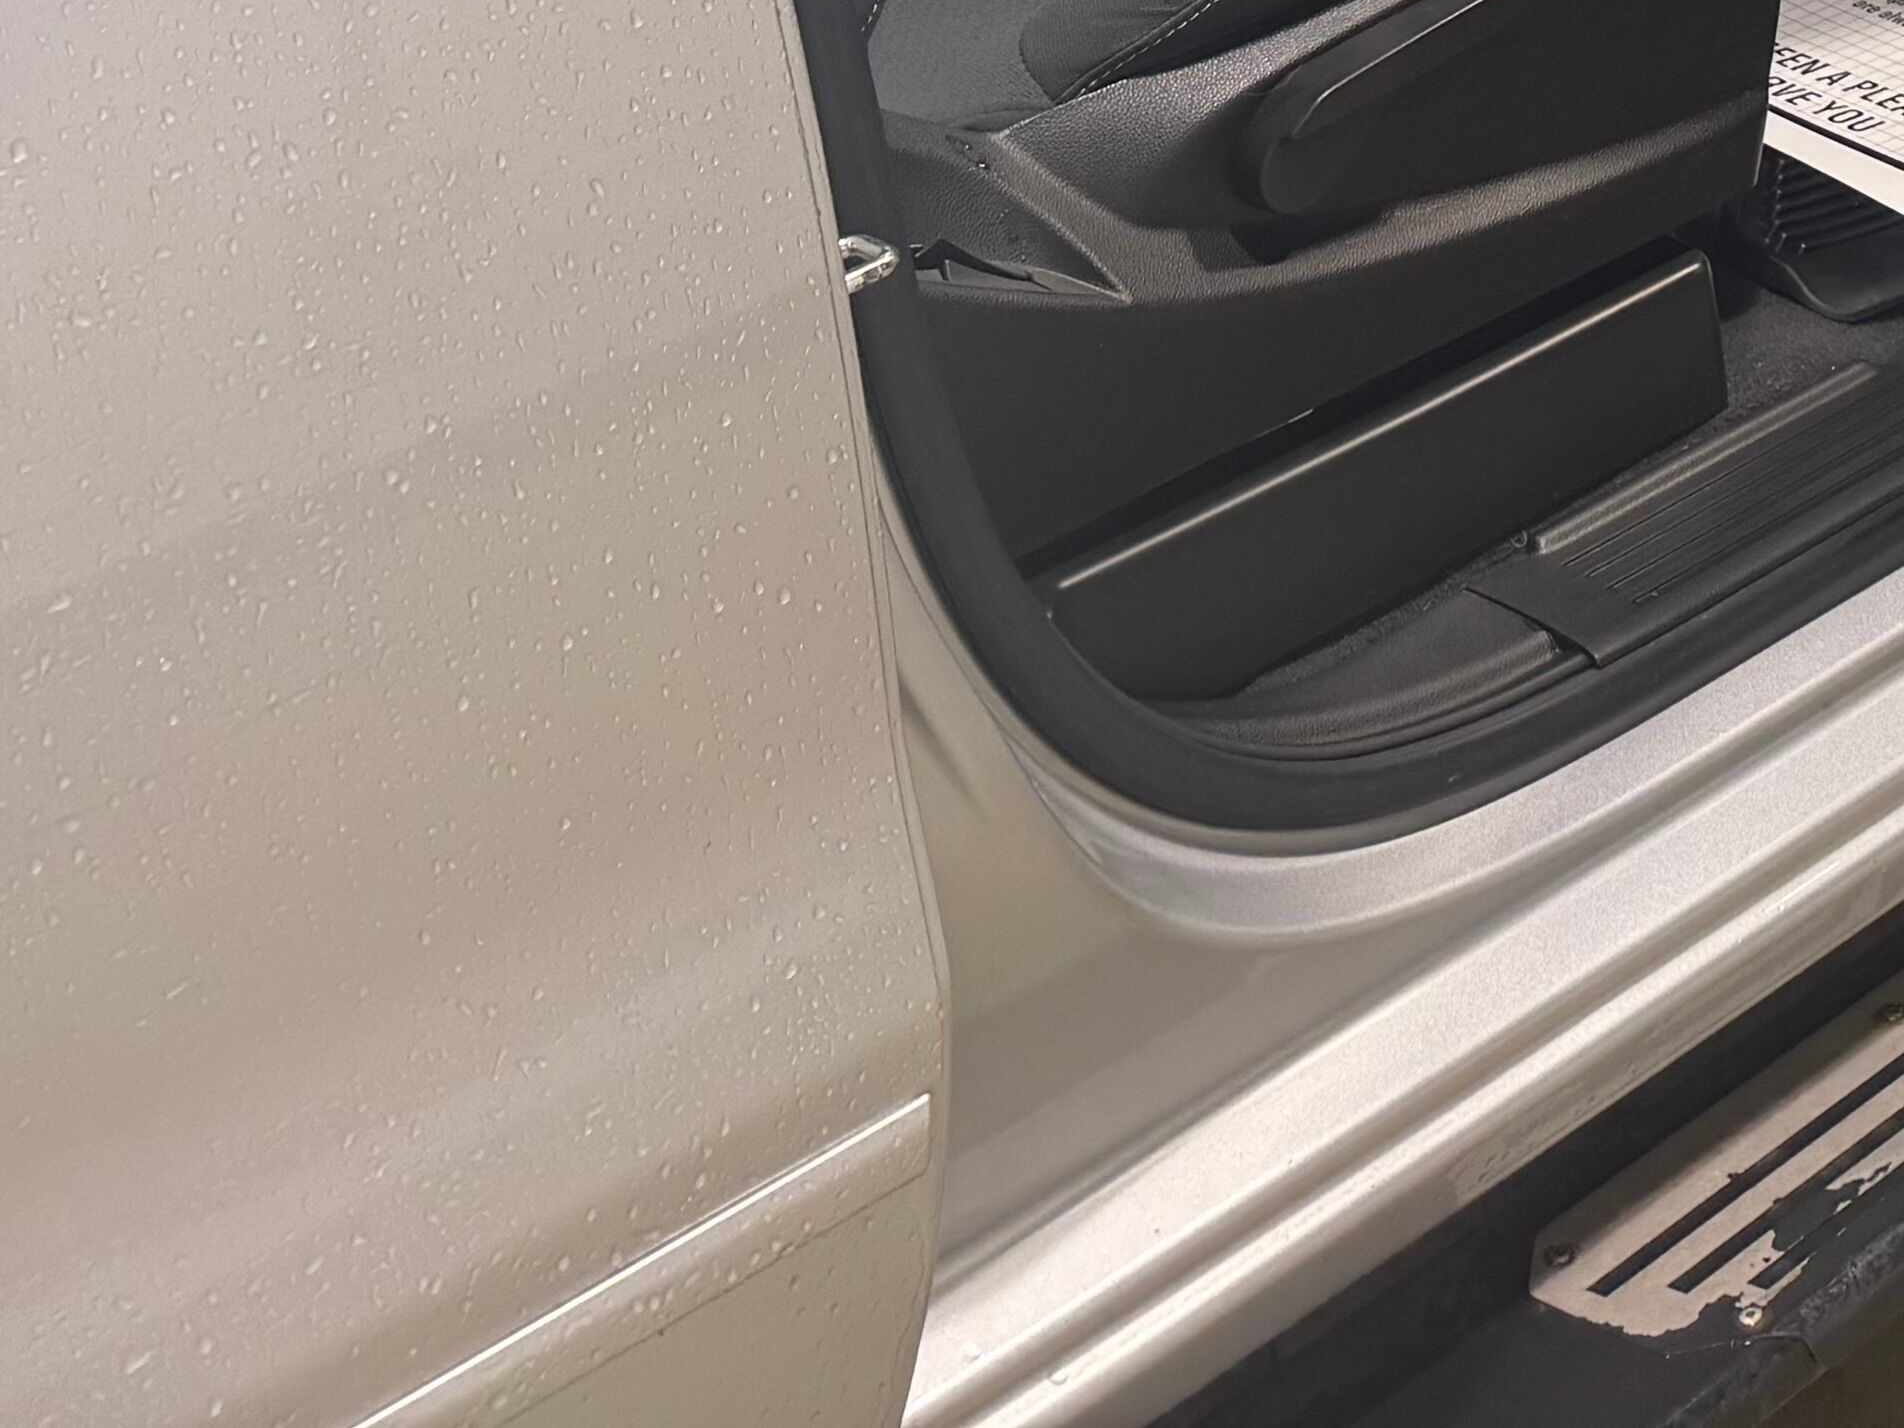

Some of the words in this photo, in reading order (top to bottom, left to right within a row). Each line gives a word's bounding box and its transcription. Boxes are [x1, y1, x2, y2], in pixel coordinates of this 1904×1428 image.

[1853, 0, 1880, 14] are
[1774, 42, 1830, 75] EEN
[1815, 71, 1852, 86] A
[1812, 100, 1885, 132] YOU
